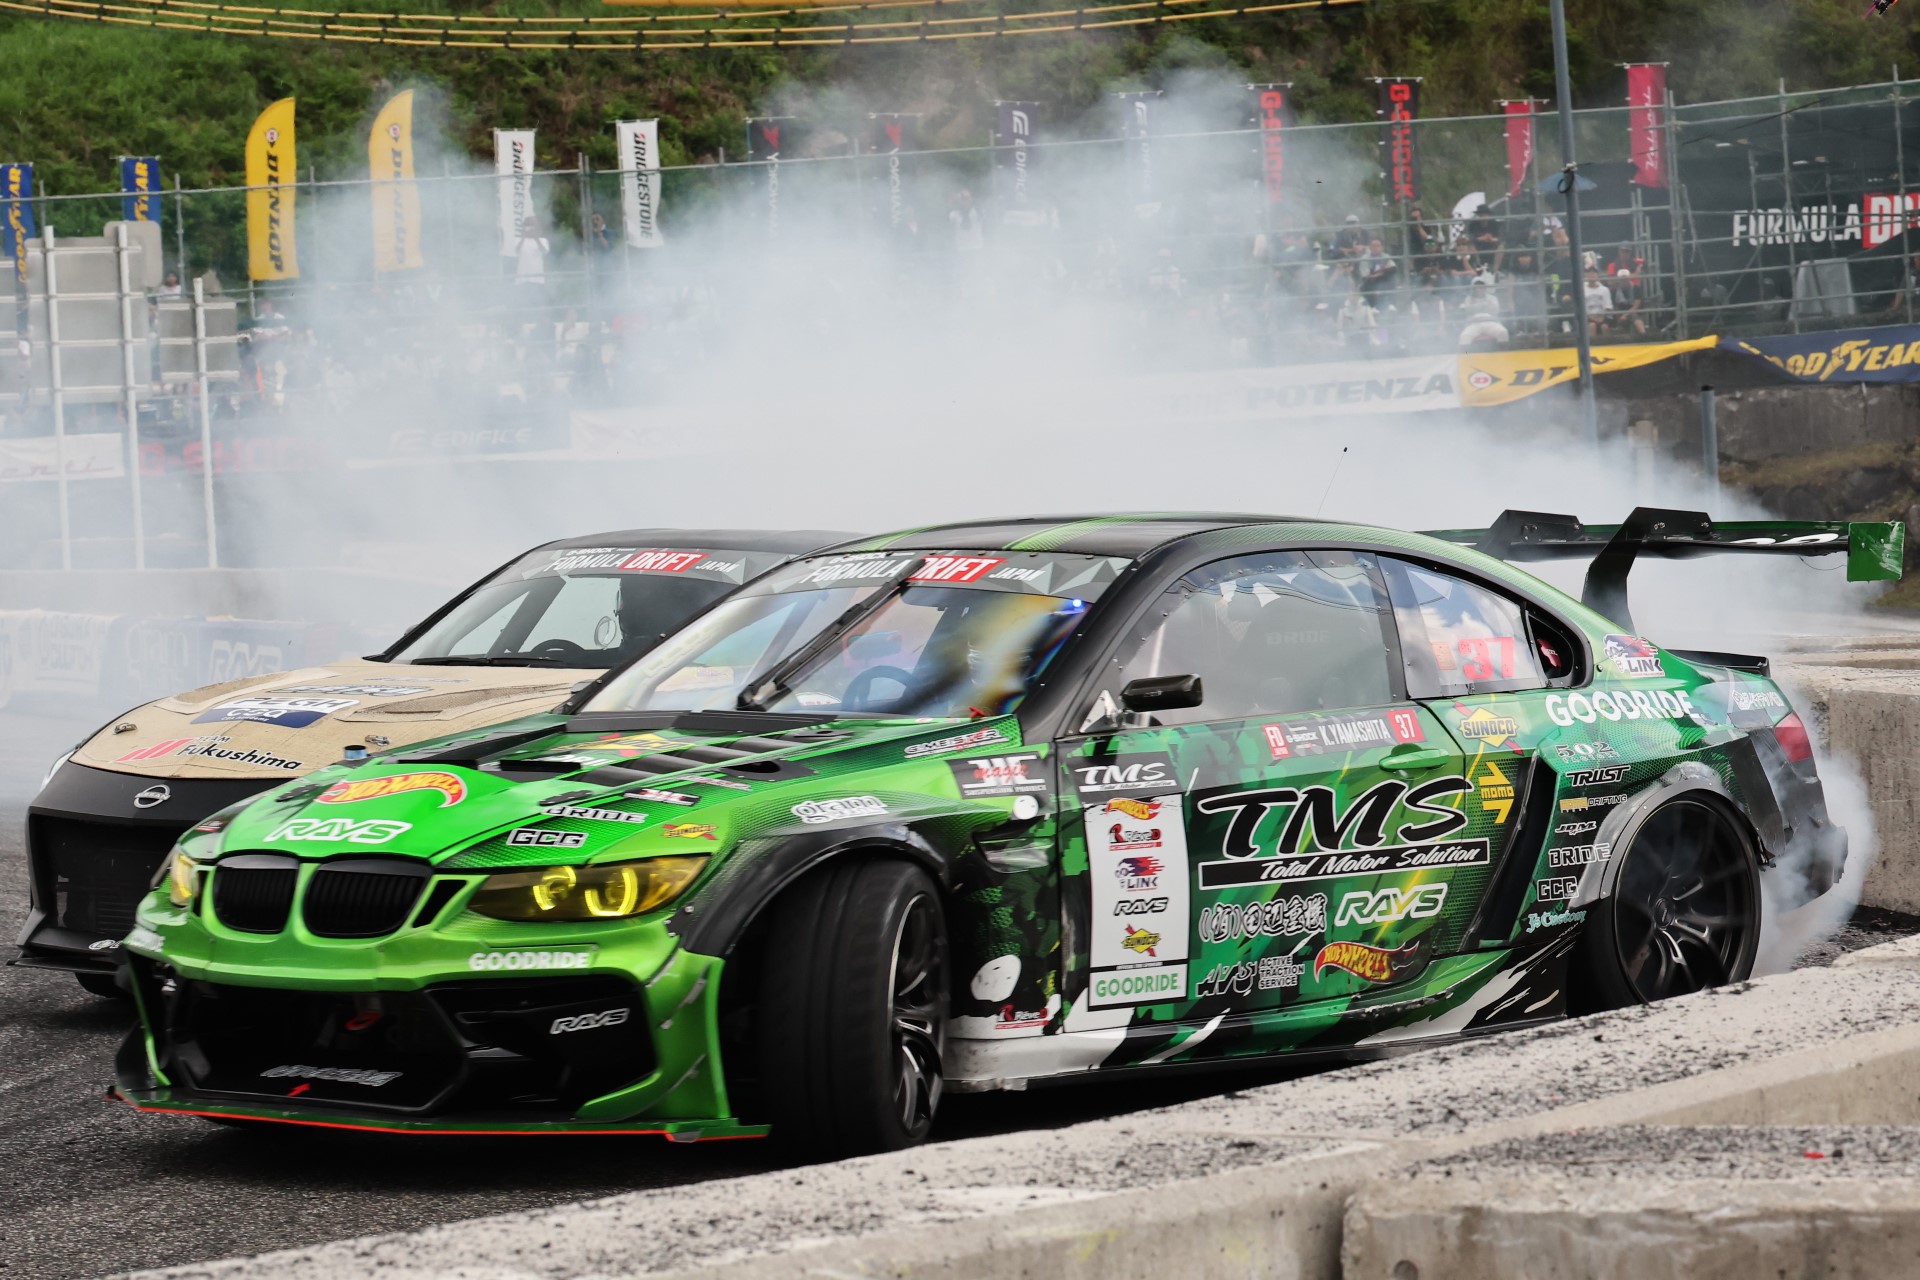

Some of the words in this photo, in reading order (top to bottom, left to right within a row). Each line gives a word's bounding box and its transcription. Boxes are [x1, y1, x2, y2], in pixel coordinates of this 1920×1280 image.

[1390, 83, 1414, 200] G-SHOCK
[512, 139, 526, 240] BRIDGESTON
[632, 131, 652, 239] BRIDGESTONE
[267, 150, 284, 273] DUNLOP
[1732, 203, 1863, 247] FORMULA
[1246, 373, 1455, 409] POTENZA
[139, 438, 318, 477] G-SHOC
[544, 552, 631, 572] FORMULA
[623, 551, 702, 571] DRIFT
[696, 560, 740, 573] JAPAN
[799, 558, 913, 584] FORMULA
[988, 567, 1045, 582] JAPAN
[1457, 636, 1515, 681] 37
[1545, 690, 1701, 727] GOODRIDE
[1318, 719, 1391, 746] K.YAMASHITA
[1395, 714, 1416, 739] 37
[1462, 720, 1517, 740] SUNOCO
[177, 743, 302, 771] Fukushima
[1075, 763, 1166, 784] TMS
[1565, 765, 1631, 787] TRUST
[1481, 786, 1514, 800] momo
[1588, 794, 1628, 807] DRIFTING
[543, 805, 647, 823] BRIDE
[1197, 776, 1475, 860] TMS
[264, 818, 413, 844] RAYS
[508, 829, 588, 848] GCG
[1260, 856, 1314, 880] Total
[1317, 852, 1389, 876] Motor
[1395, 846, 1481, 871] Solution
[1549, 843, 1612, 867] BRIDE
[1537, 876, 1580, 901] GCG
[1114, 897, 1169, 916] RAYS
[1334, 883, 1448, 927] RAYS
[469, 951, 591, 971] GOODRIDE
[1259, 956, 1294, 969] ACTIVE
[1259, 964, 1305, 978] TRACTION
[1095, 972, 1179, 998] GOODRIDE
[1258, 975, 1298, 990] SERVICE
[550, 1008, 630, 1035] RAYS
